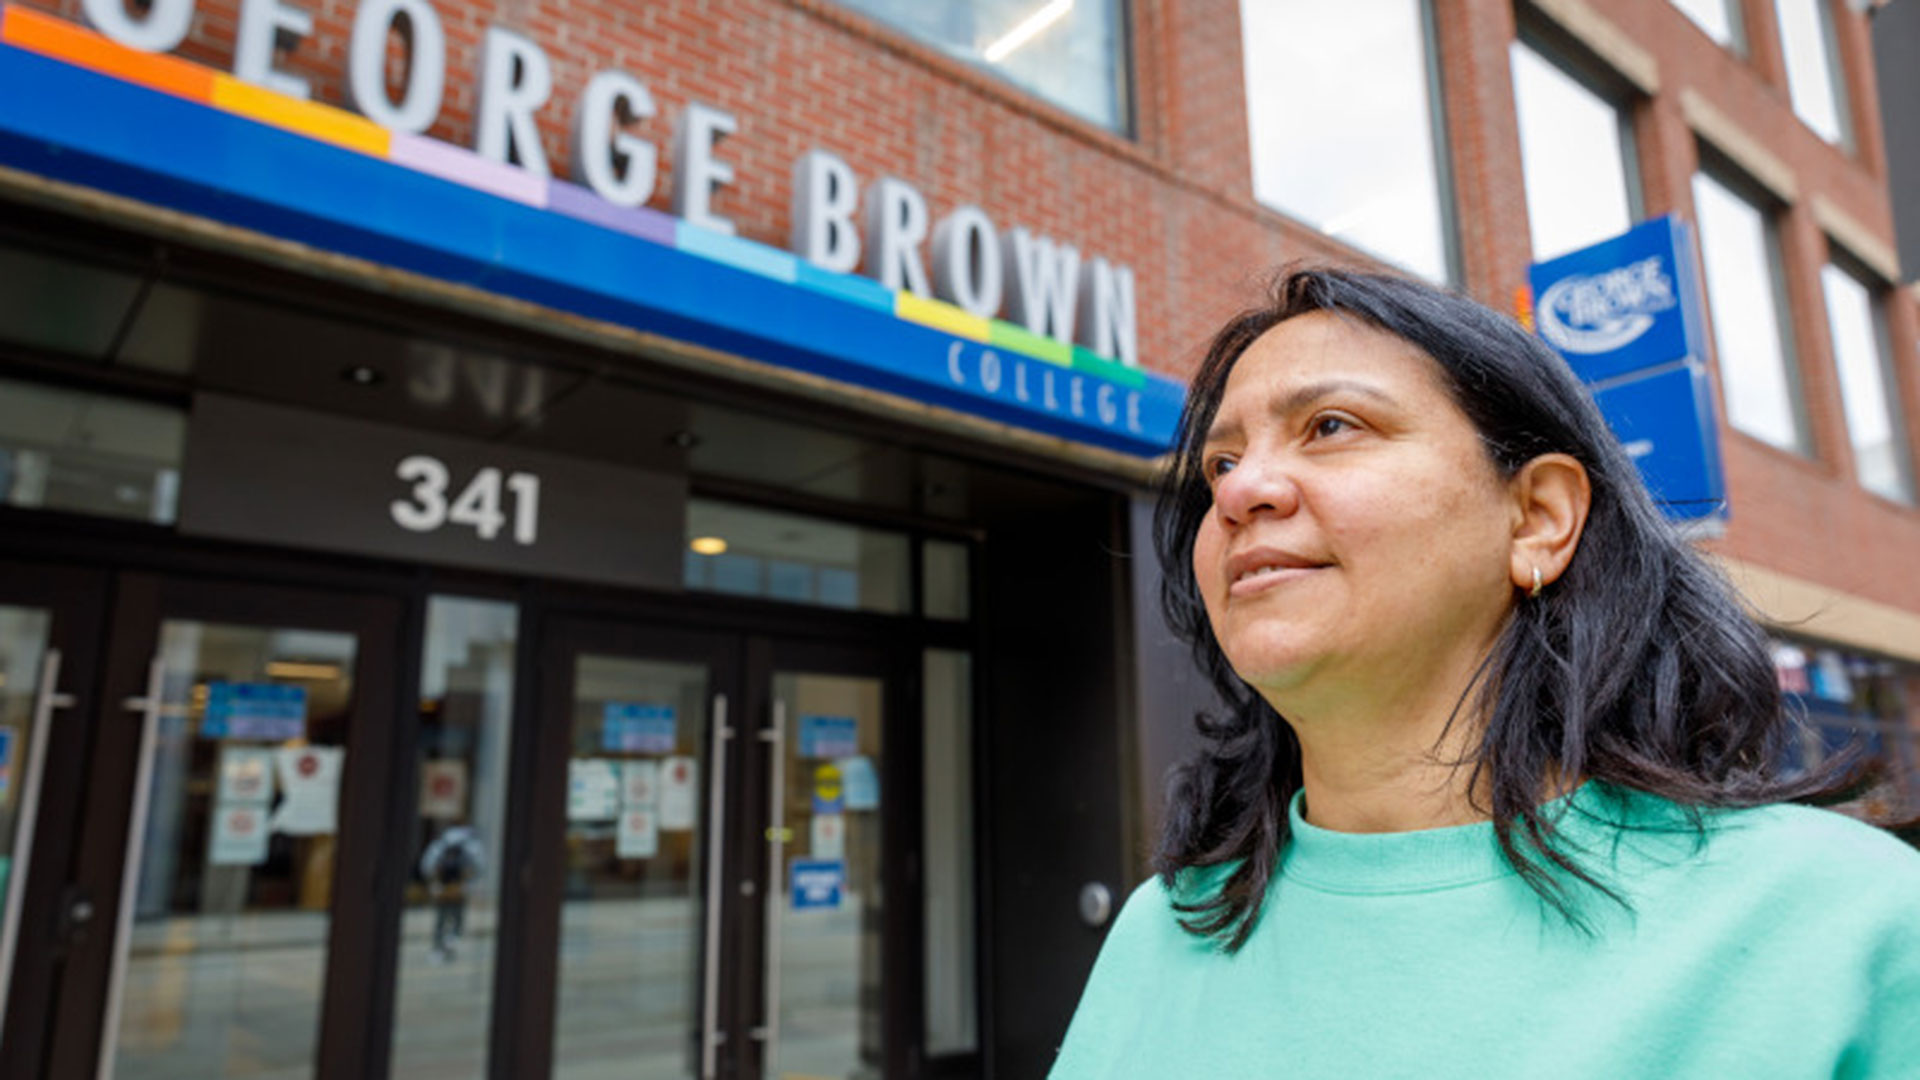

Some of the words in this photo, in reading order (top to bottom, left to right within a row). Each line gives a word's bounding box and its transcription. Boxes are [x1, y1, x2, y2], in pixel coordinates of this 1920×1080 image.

[797, 149, 1139, 368] BROWN
[948, 340, 1144, 434] COLLEGE
[389, 455, 541, 545] 341
